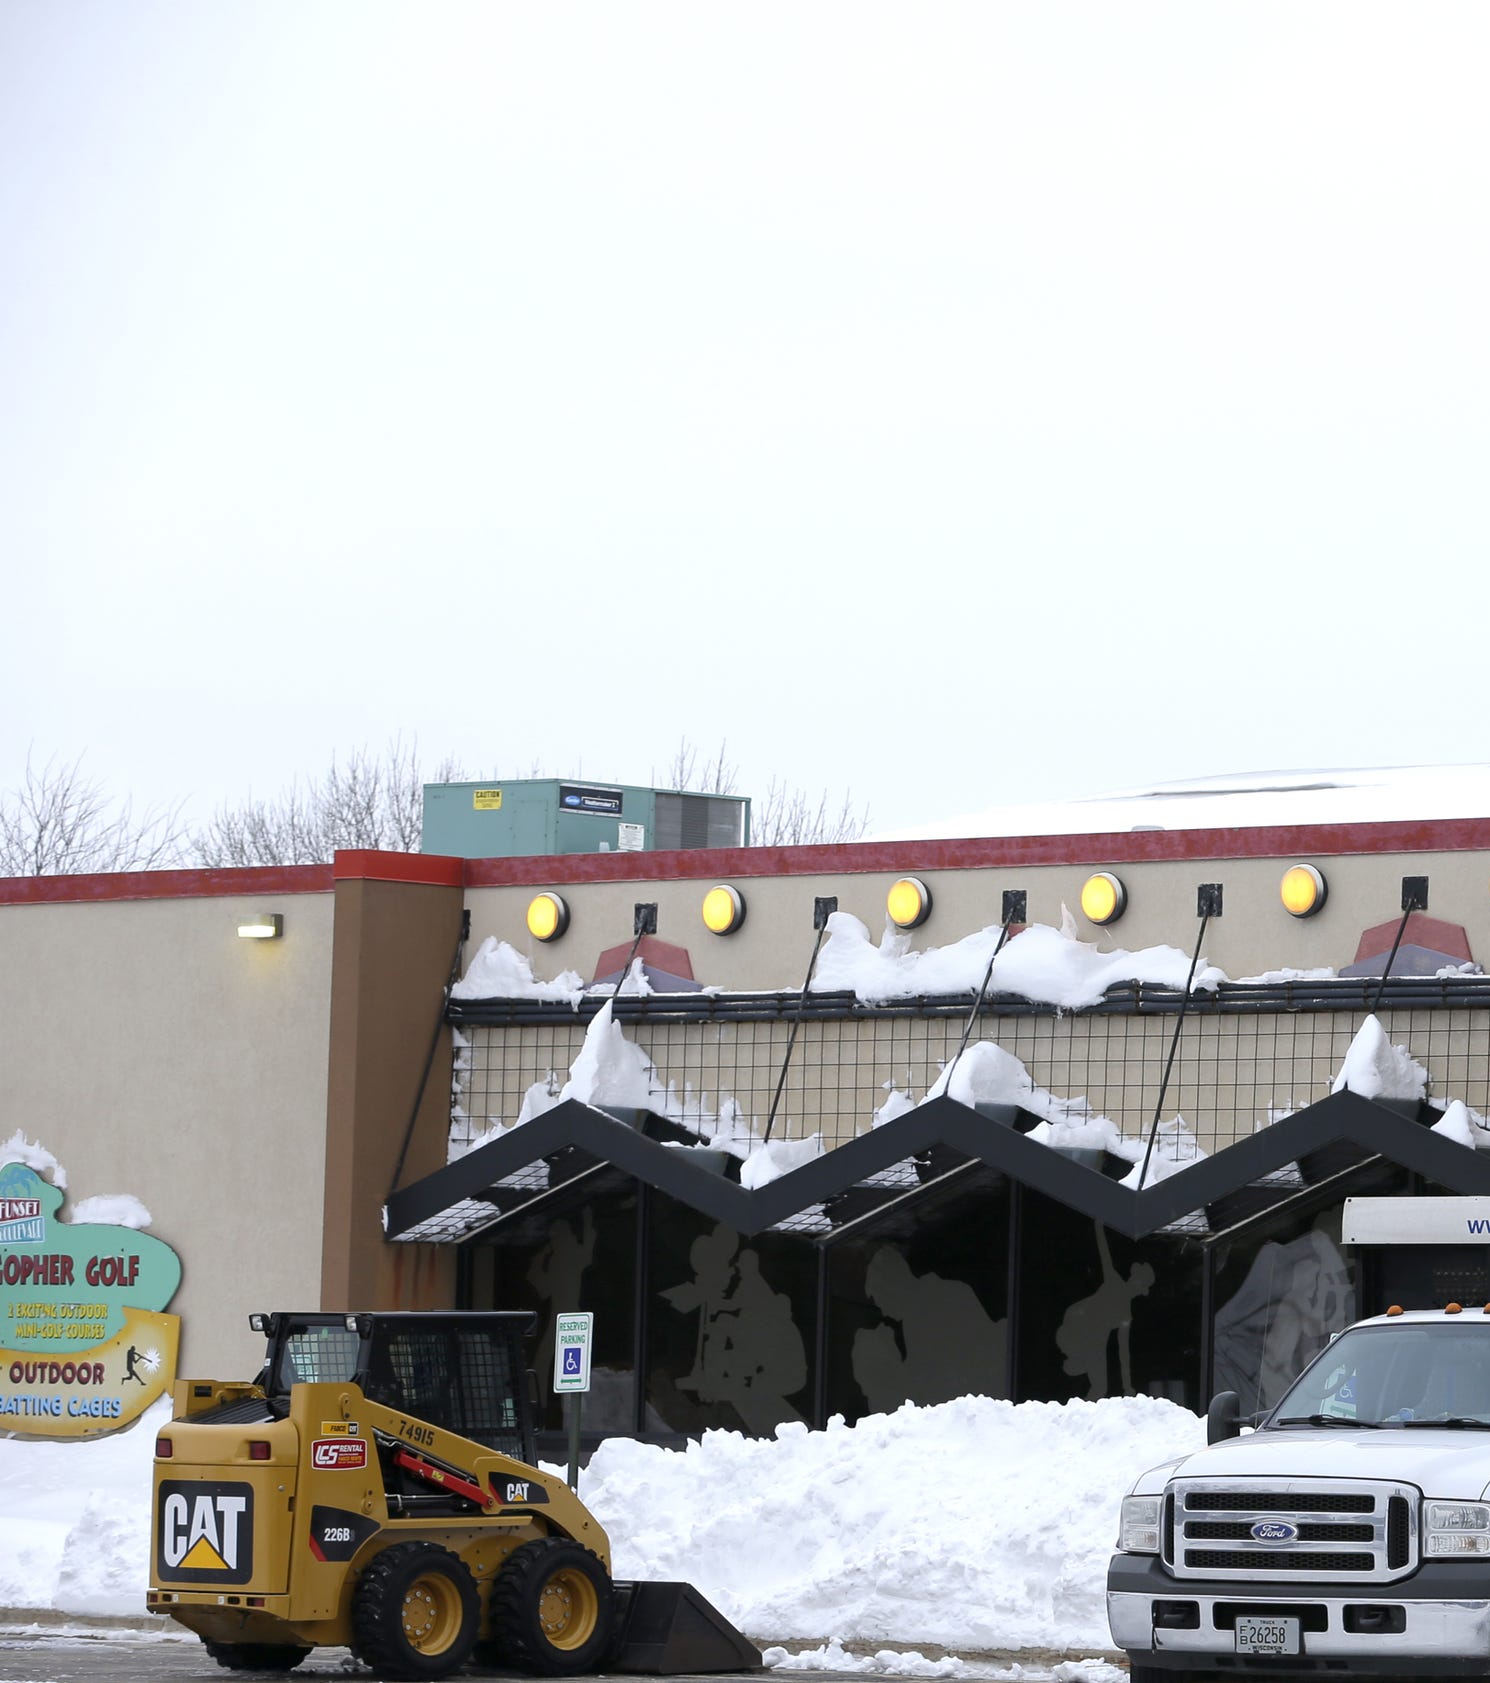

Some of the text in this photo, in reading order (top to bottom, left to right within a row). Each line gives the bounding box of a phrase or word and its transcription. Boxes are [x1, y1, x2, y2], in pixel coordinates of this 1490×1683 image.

[0, 1255, 140, 1287] OPHER GOLF
[8, 1303, 108, 1319] 2 EXCITING OUTDOOR
[16, 1322, 105, 1339] MINI-GOLF COURSES
[559, 1321, 588, 1331] RESERVED
[560, 1335, 586, 1345] PARKING
[9, 1361, 105, 1385] OUTDOOR
[67, 1397, 122, 1419] CAGES
[398, 1420, 435, 1446] 74915
[340, 1444, 364, 1452] RENTAL
[506, 1483, 530, 1501] CAT
[164, 1493, 247, 1569] CAT
[1260, 1524, 1286, 1538] Ford
[1250, 1626, 1286, 1643] 26258
